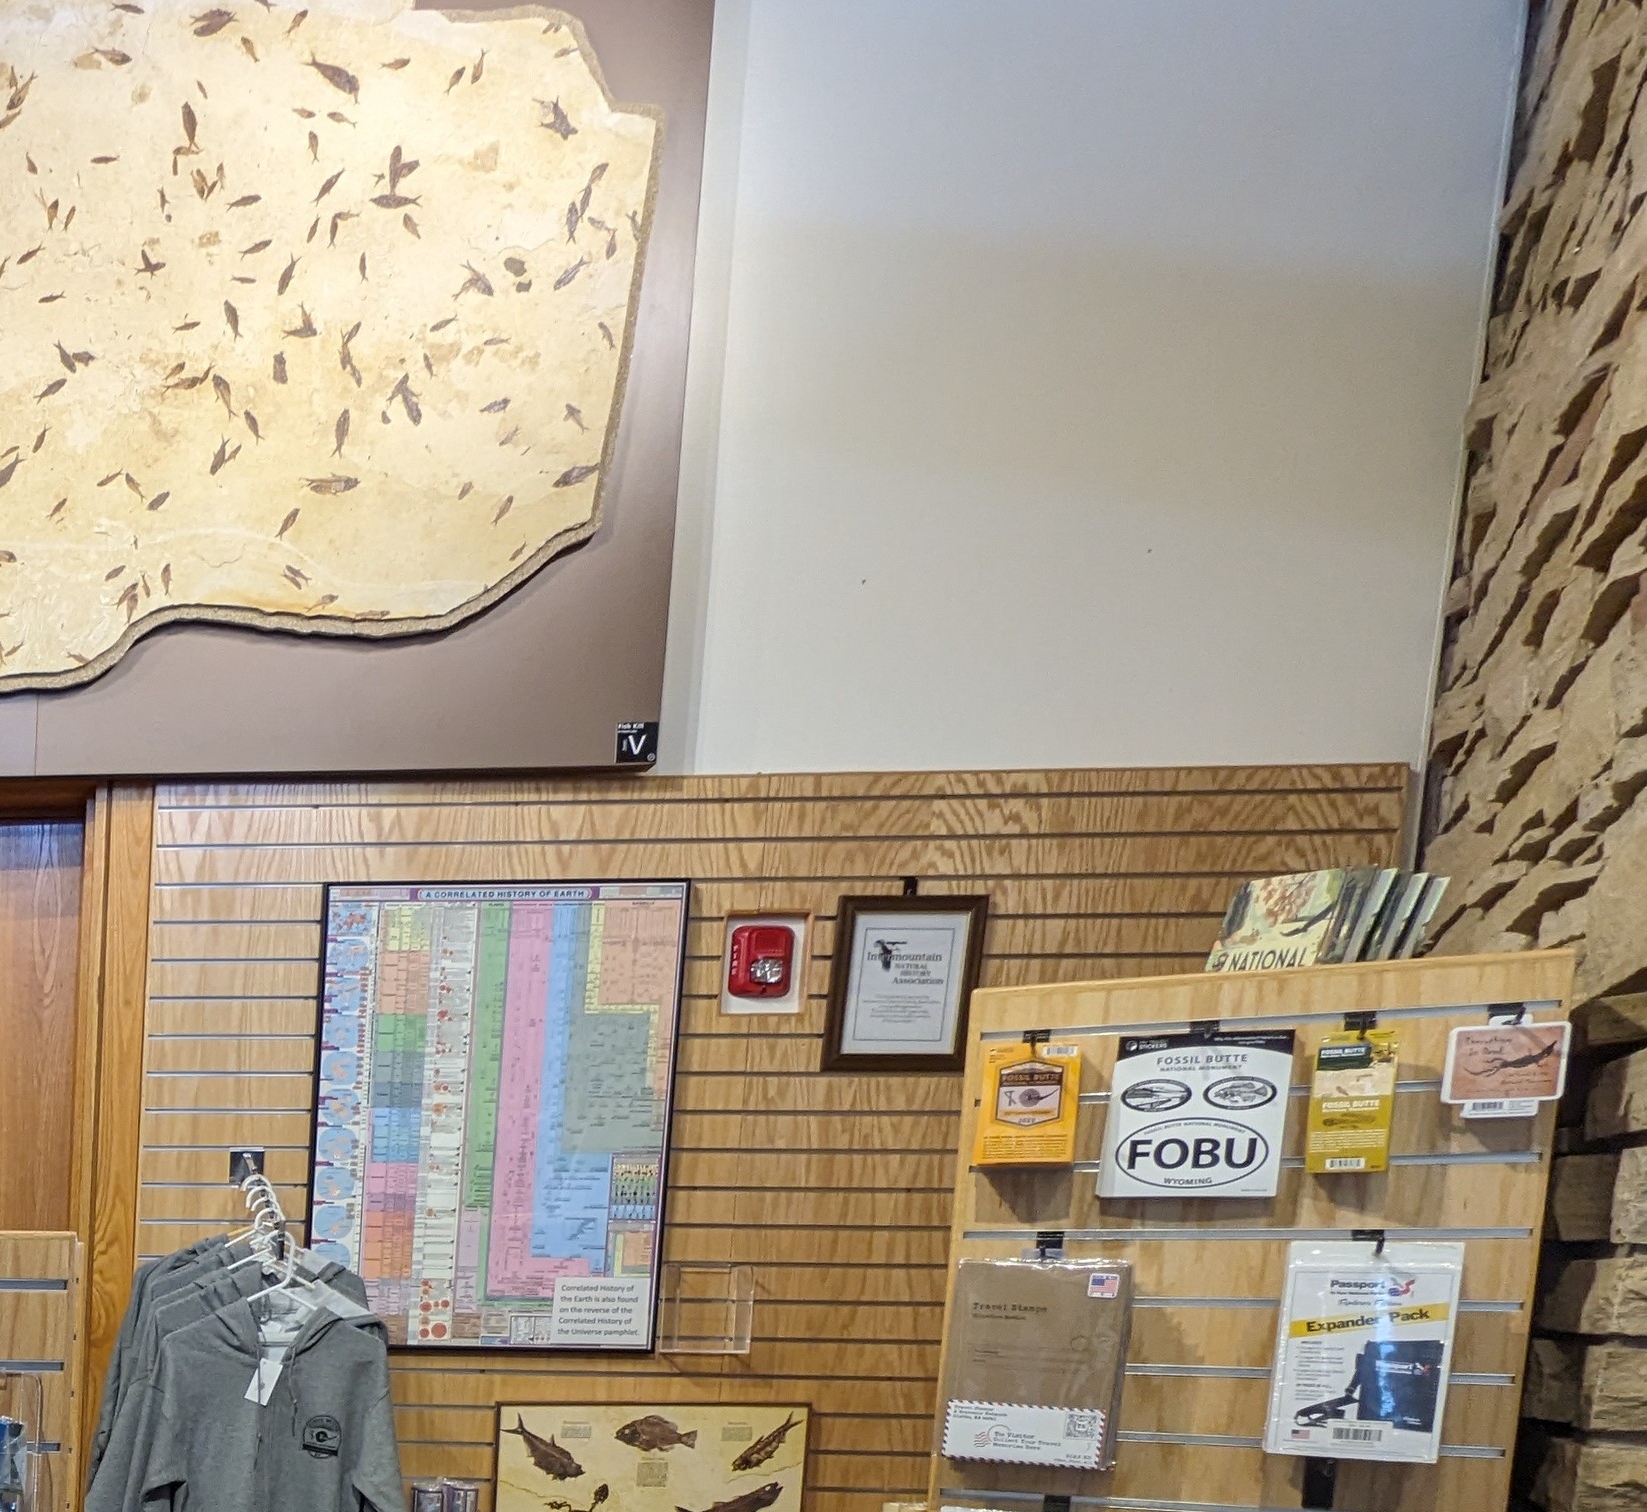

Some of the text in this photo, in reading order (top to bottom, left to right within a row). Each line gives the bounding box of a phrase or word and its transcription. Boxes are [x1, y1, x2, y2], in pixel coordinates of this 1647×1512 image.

[434, 890, 494, 898] CORRELATED
[497, 890, 536, 898] HISTORY
[1228, 948, 1305, 971] NATIONAL
[1157, 1054, 1248, 1065] FOSSIL BUTTE
[1127, 1138, 1258, 1170] FOBU
[1164, 1177, 1212, 1185] WYOMING
[1331, 1280, 1385, 1289] Passport
[1389, 1308, 1430, 1322] Pack
